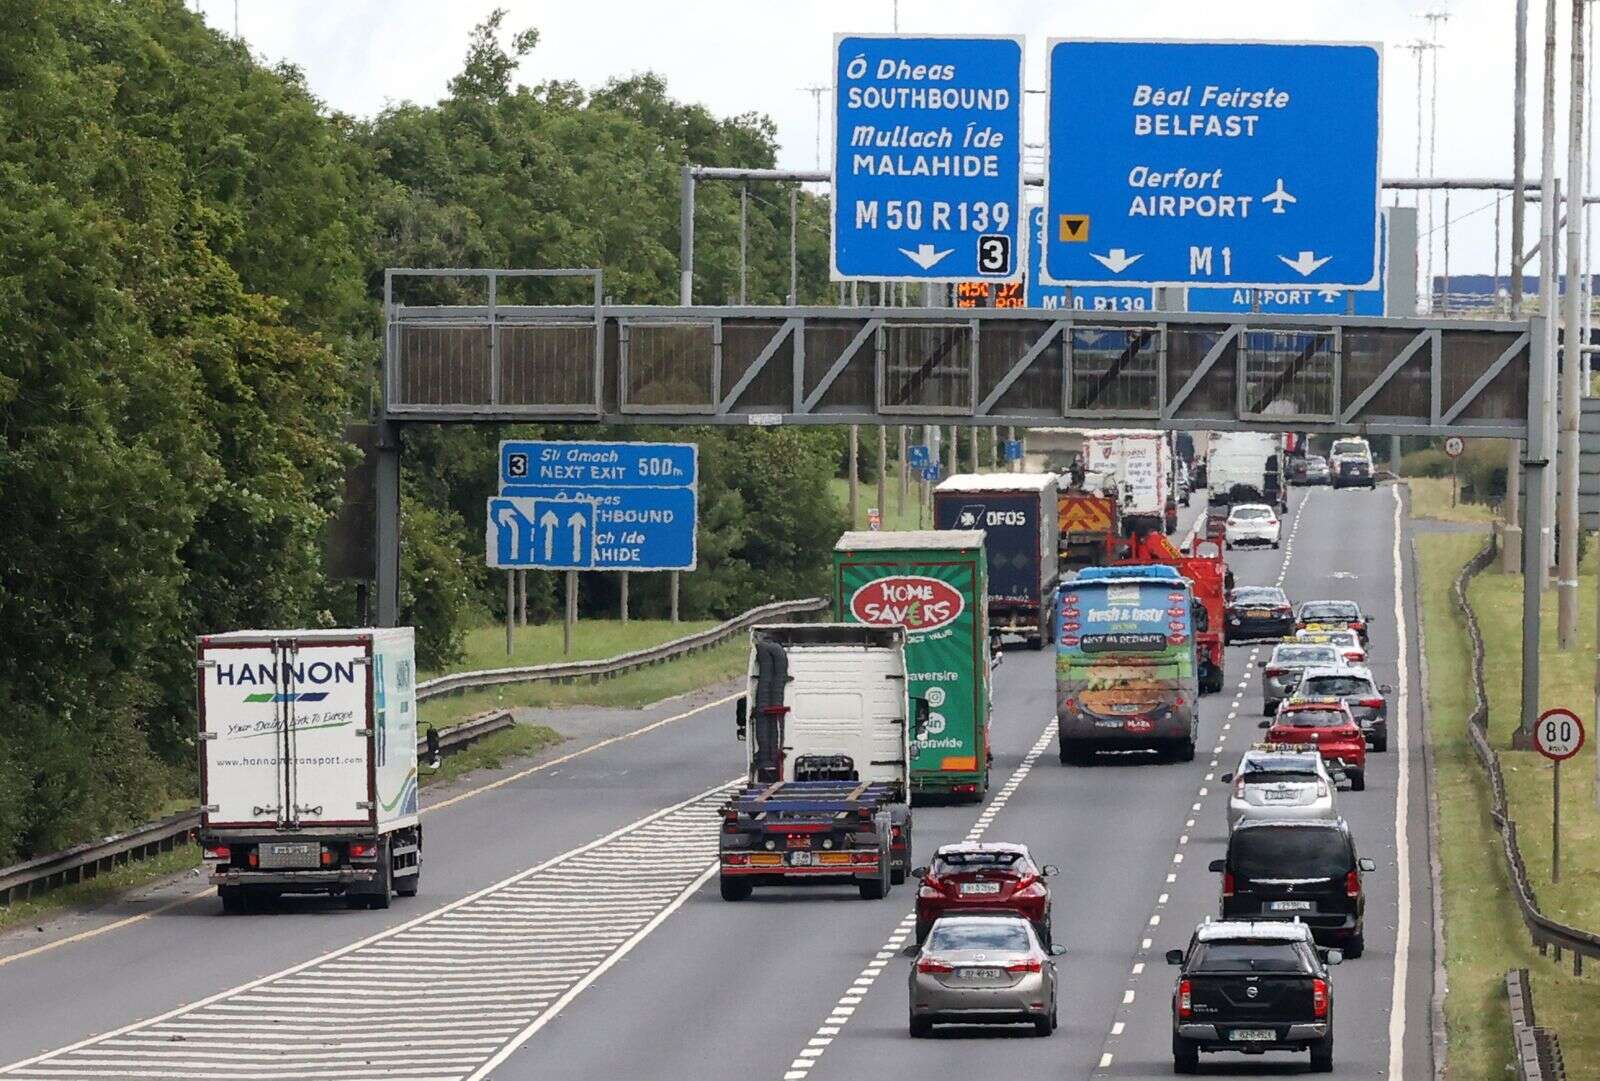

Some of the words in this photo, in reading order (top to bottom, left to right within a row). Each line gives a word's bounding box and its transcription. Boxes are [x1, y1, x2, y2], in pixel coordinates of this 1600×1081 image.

[847, 54, 867, 79] Ó
[877, 59, 956, 81] Dheas
[848, 86, 1009, 111] SOUTHBOUND
[1132, 85, 1192, 107] Béal
[1200, 85, 1290, 109] Feirste
[851, 125, 953, 149] Mullach
[962, 122, 1004, 148] Íde
[1134, 114, 1259, 137] BELFAST
[853, 155, 999, 177] MALAHIDE
[1128, 165, 1223, 189] Aerfort
[1128, 195, 1253, 218] AIRPORT
[982, 240, 1004, 270] 3
[511, 457, 526, 475] 3
[540, 466, 585, 479] NEXT
[591, 466, 626, 479] EXIT
[881, 583, 934, 602] HOME
[216, 661, 355, 686] HANNON
[1546, 721, 1571, 742] 80
